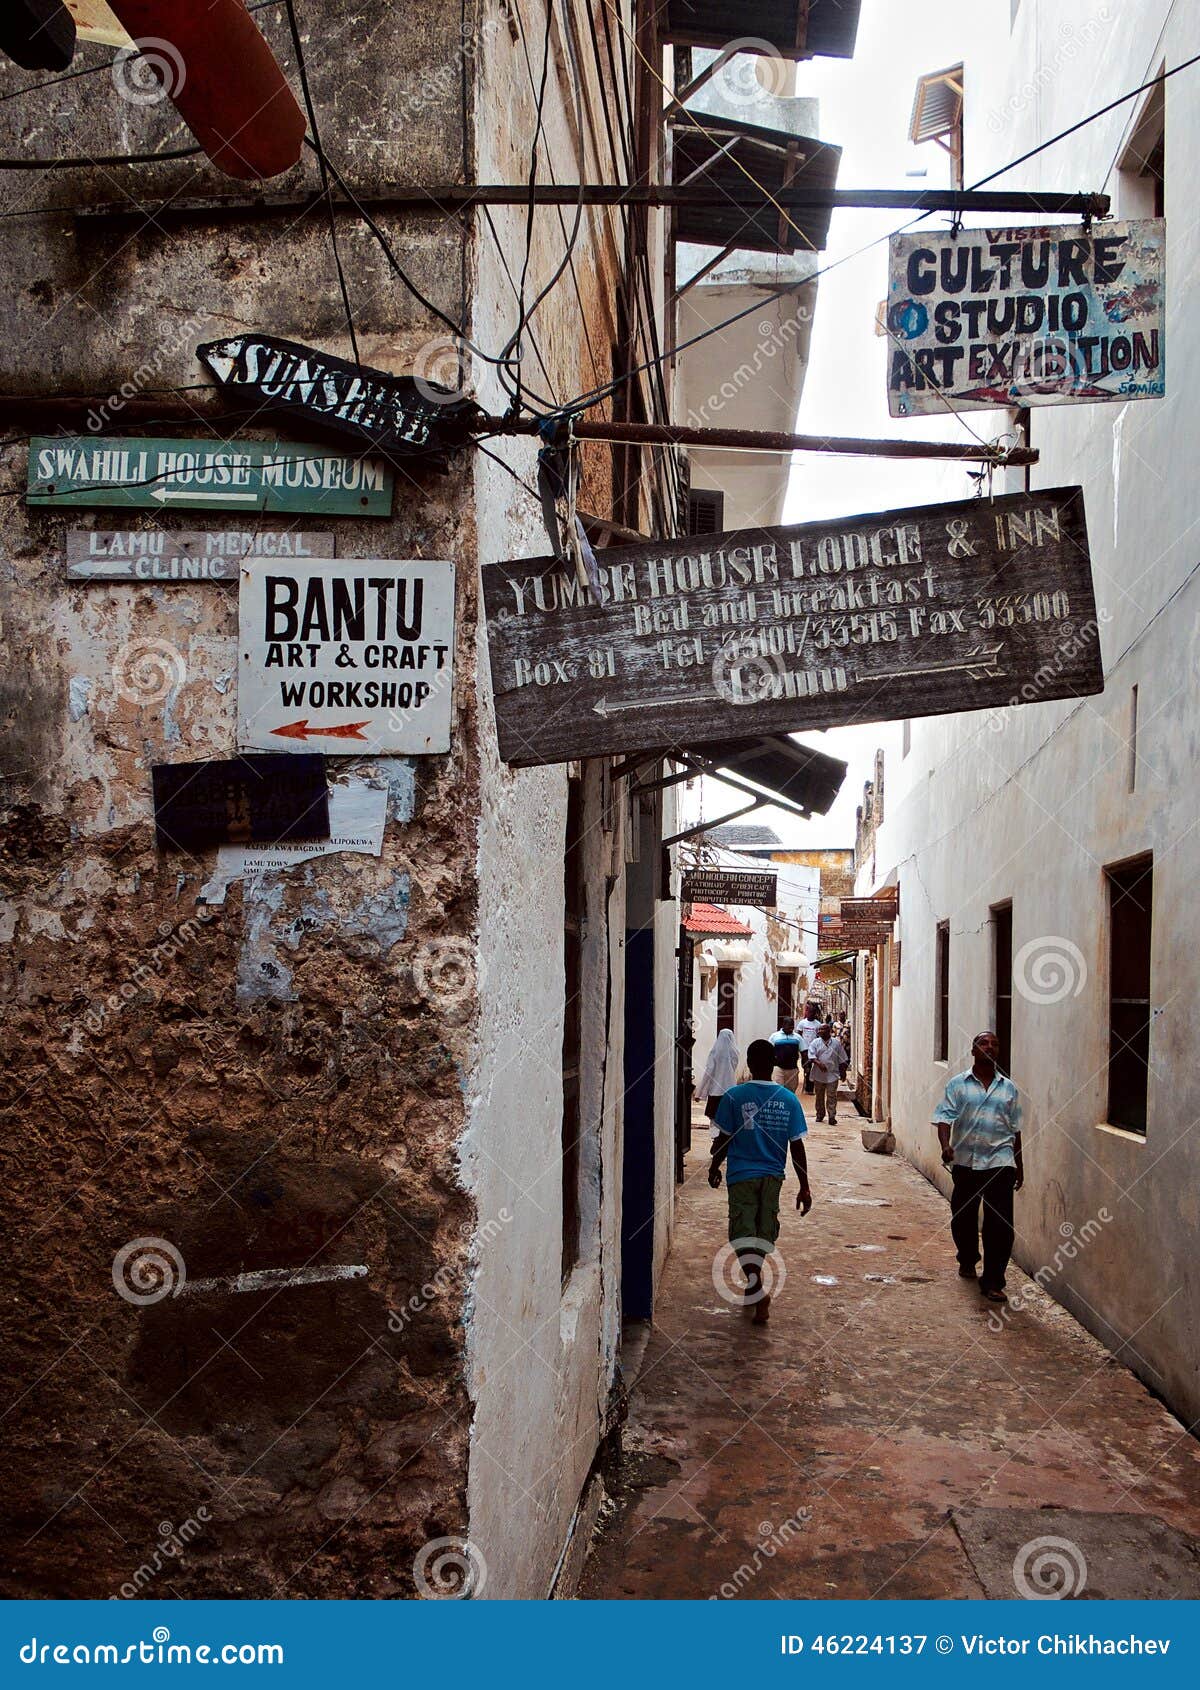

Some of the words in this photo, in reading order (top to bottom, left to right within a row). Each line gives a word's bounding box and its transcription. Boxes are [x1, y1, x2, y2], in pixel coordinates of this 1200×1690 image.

[907, 237, 1128, 295] CULTURE
[935, 292, 1087, 344] STUDIO
[890, 346, 965, 390] ART
[37, 448, 147, 483] SWAHILI
[157, 451, 252, 486] HOUSE
[261, 455, 385, 492] MUSEUM
[89, 532, 165, 556] LAMU
[650, 543, 779, 598] HOUSE
[789, 524, 923, 579] LODGE
[945, 519, 979, 559] &
[995, 507, 1061, 550] INN
[135, 557, 227, 579] CLINIC
[265, 576, 424, 642] BANTU
[633, 600, 690, 636] Bed
[702, 591, 757, 627] and
[773, 566, 939, 619] breakfast
[265, 643, 321, 668] ART
[334, 643, 358, 668] &
[364, 645, 449, 669] CRAFT
[515, 658, 571, 687] Box
[588, 648, 617, 678] 81
[908, 605, 968, 637] Fax
[280, 681, 430, 708] WORKSHOP
[244, 859, 264, 867] LAMU
[738, 874, 775, 885] CONCEPT
